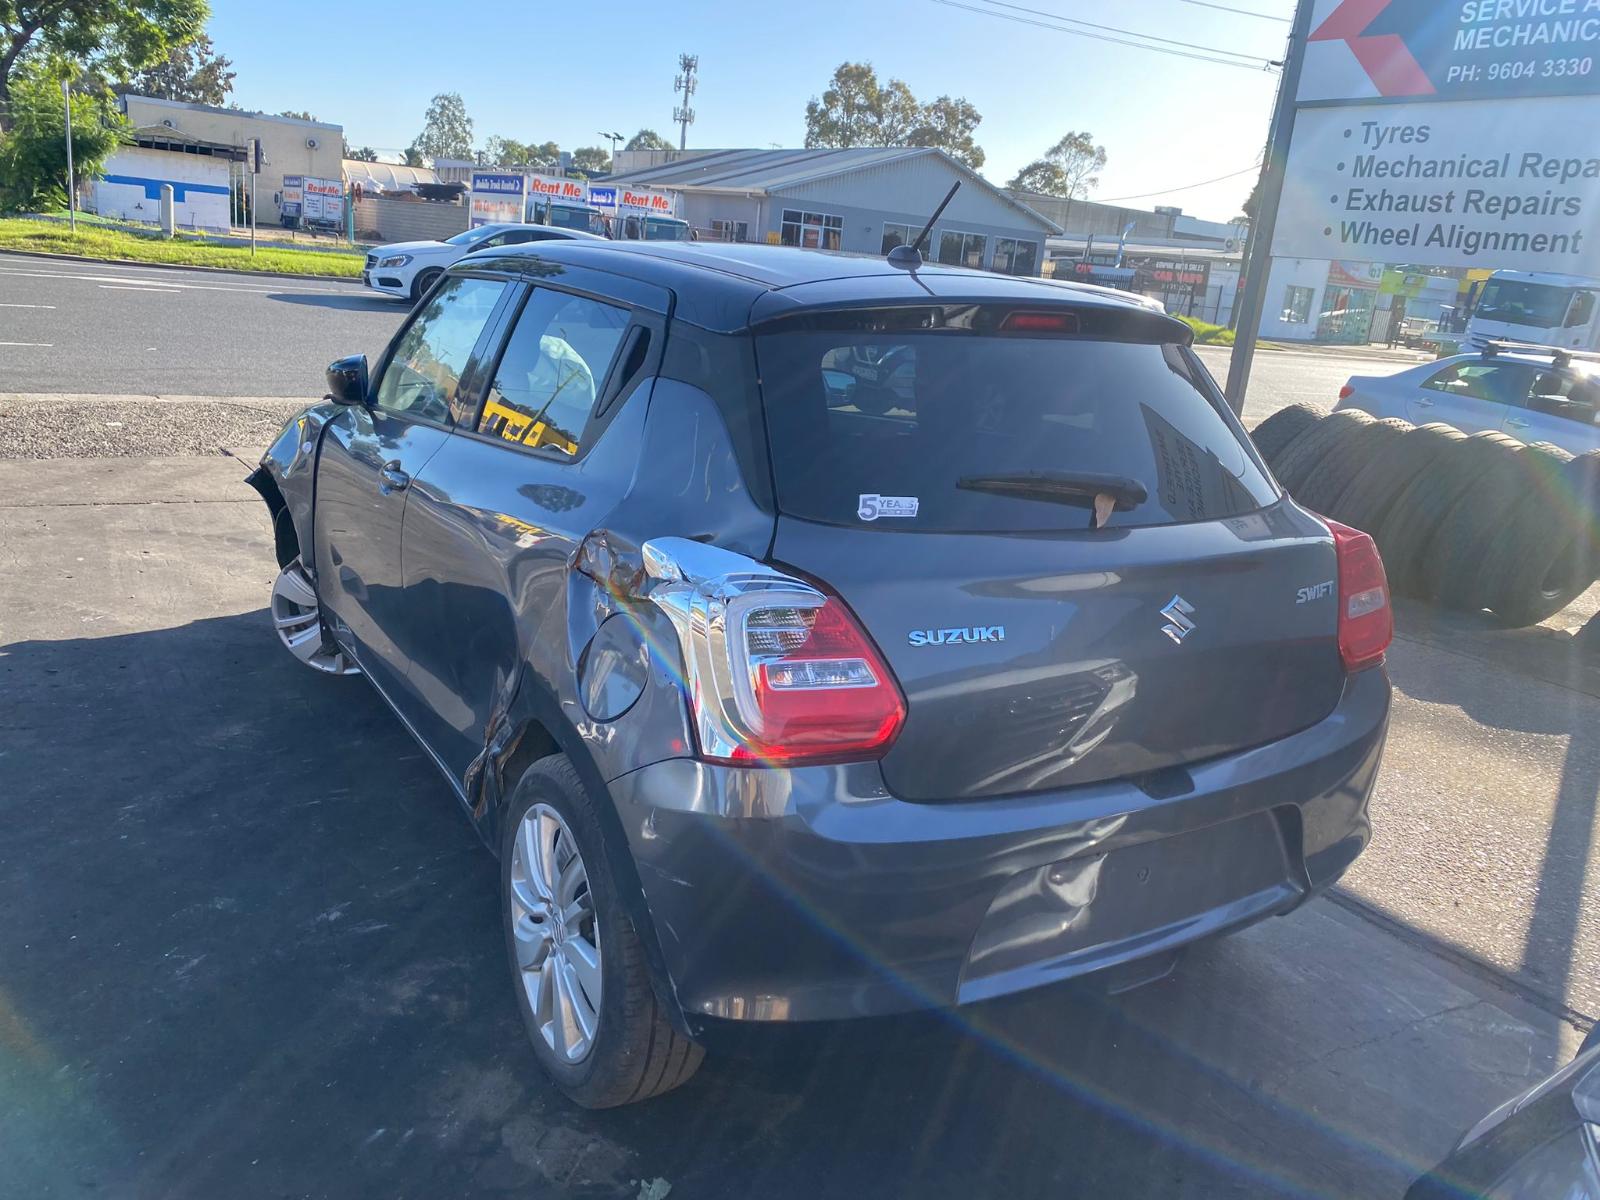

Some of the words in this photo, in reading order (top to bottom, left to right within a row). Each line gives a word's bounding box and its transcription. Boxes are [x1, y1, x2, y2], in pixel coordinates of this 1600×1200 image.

[1460, 0, 1576, 23] SERVICE
[1453, 18, 1600, 51] MECHANIC
[1447, 64, 1481, 83] PH:
[1487, 60, 1535, 80] 9604
[1541, 57, 1593, 77] 3330
[1360, 120, 1430, 150] Tyres
[1351, 152, 1511, 178] Mechanical
[1518, 152, 1600, 184] Repa
[307, 183, 328, 193] Rent
[328, 186, 340, 195] Me
[532, 178, 561, 194] Rent
[563, 182, 582, 197] Me
[623, 191, 650, 206] Rent
[652, 195, 669, 209] Me
[1344, 187, 1455, 213] Exhaust
[1463, 189, 1582, 220] Repairs
[1339, 221, 1419, 246] Wheel
[1424, 223, 1583, 255] Alignment
[861, 496, 878, 519] 5
[1296, 580, 1334, 604] SWIFT
[908, 626, 1005, 646] SUZUKI
